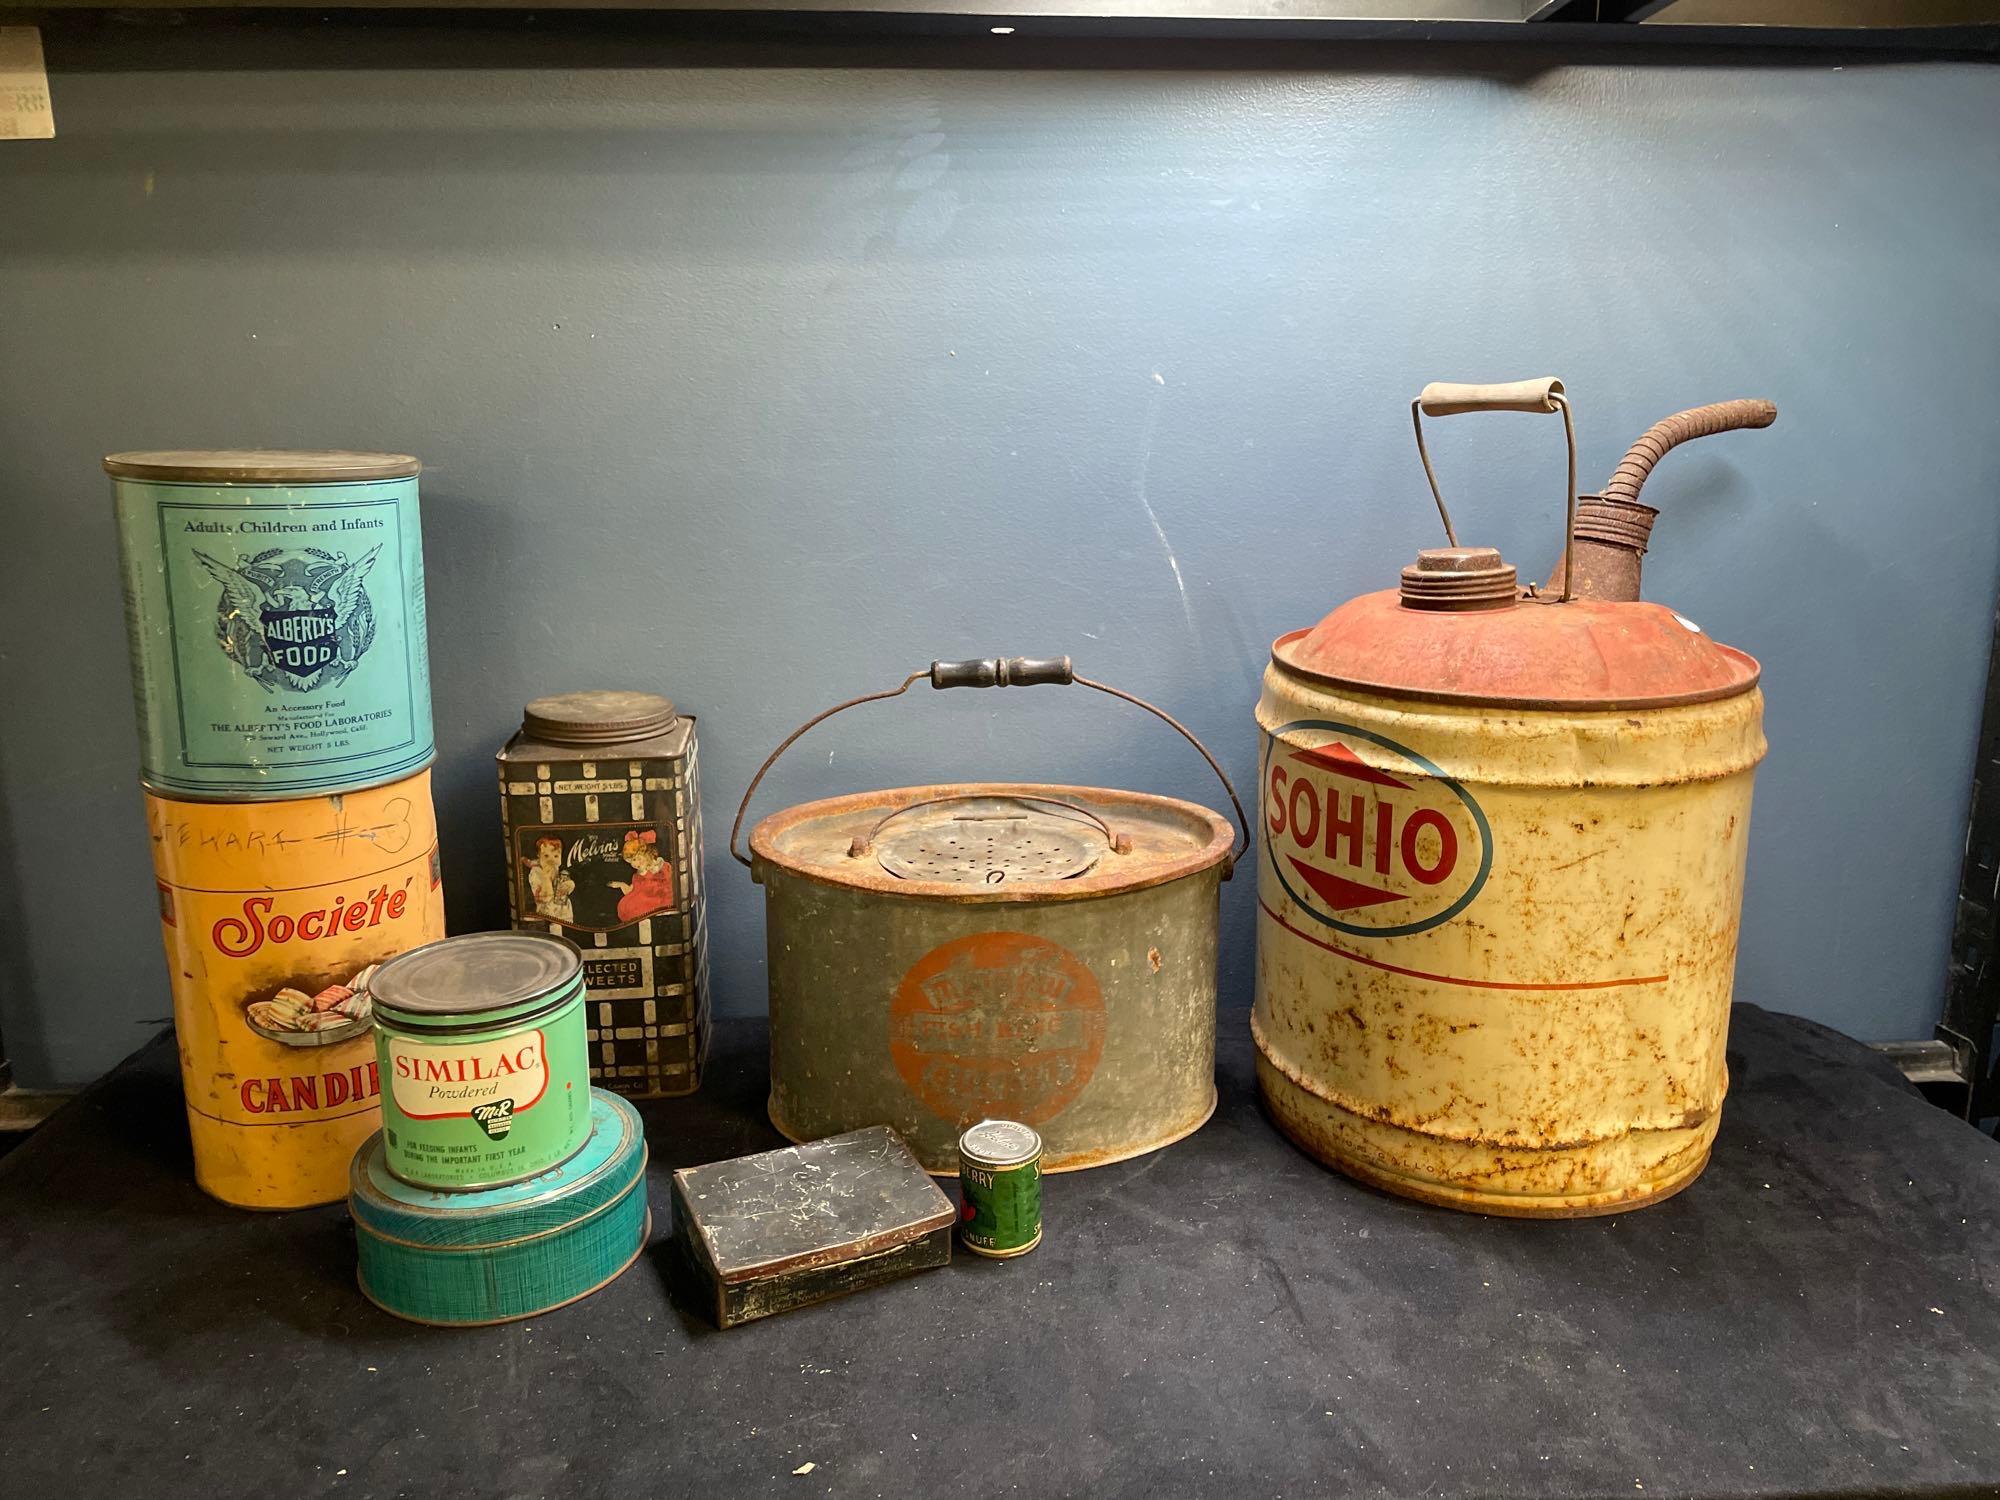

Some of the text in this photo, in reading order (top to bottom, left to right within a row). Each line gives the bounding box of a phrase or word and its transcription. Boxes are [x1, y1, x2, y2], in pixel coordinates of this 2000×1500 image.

[184, 518, 384, 534] Adults, Children and Infants
[311, 567, 340, 592] STRENGTH
[267, 614, 334, 643] ALBERTY'S
[272, 646, 331, 666] FOOD
[265, 699, 346, 713] An Accessory Food
[210, 723, 231, 733] THE
[293, 720, 322, 730] FOOD
[325, 709, 393, 727] LABORATORIES
[289, 743, 322, 752] WEIGHT
[1270, 765, 1458, 885] SOHIO
[567, 838, 619, 867] Melvin's
[583, 963, 637, 974] LECTED
[583, 974, 636, 986] WEETS
[396, 1046, 535, 1083] SIMILAC
[428, 1082, 499, 1099] Powdered
[420, 1143, 445, 1153] FEEDING
[448, 1145, 478, 1154] INFANTS
[427, 1155, 438, 1163] THE
[442, 1155, 481, 1164] IMPORTANT
[485, 1151, 505, 1162] FIRST
[508, 1146, 526, 1157] YEAR
[1378, 1152, 1463, 1176] GALLONS
